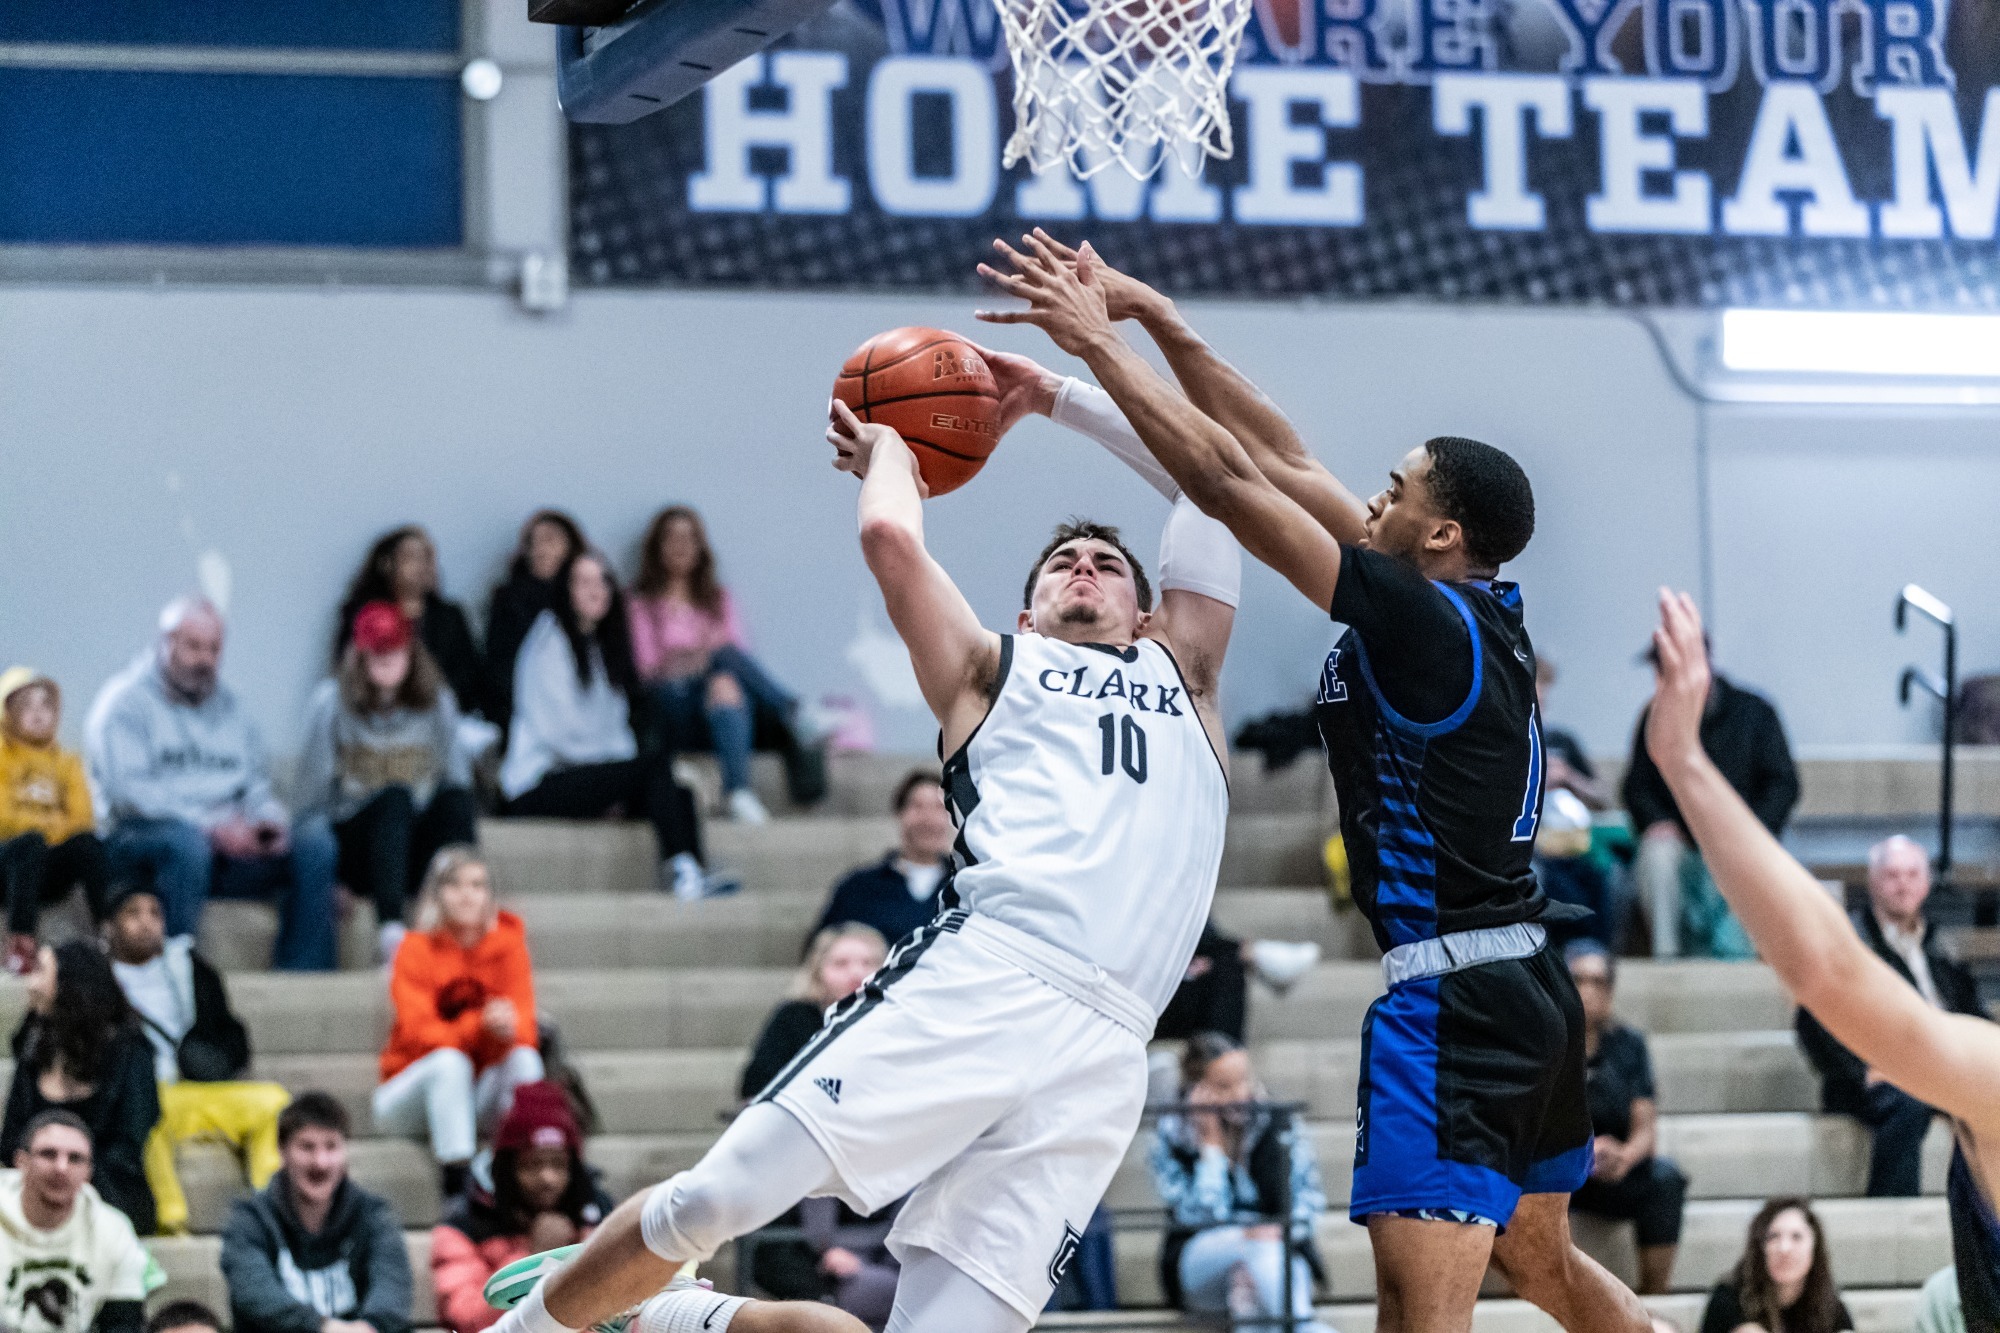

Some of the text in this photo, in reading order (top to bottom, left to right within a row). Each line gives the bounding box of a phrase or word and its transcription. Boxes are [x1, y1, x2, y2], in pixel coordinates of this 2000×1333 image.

[688, 50, 2000, 239] HOME TEAM
[1039, 666, 1183, 716] CLARK
[1098, 712, 1147, 784] 10
